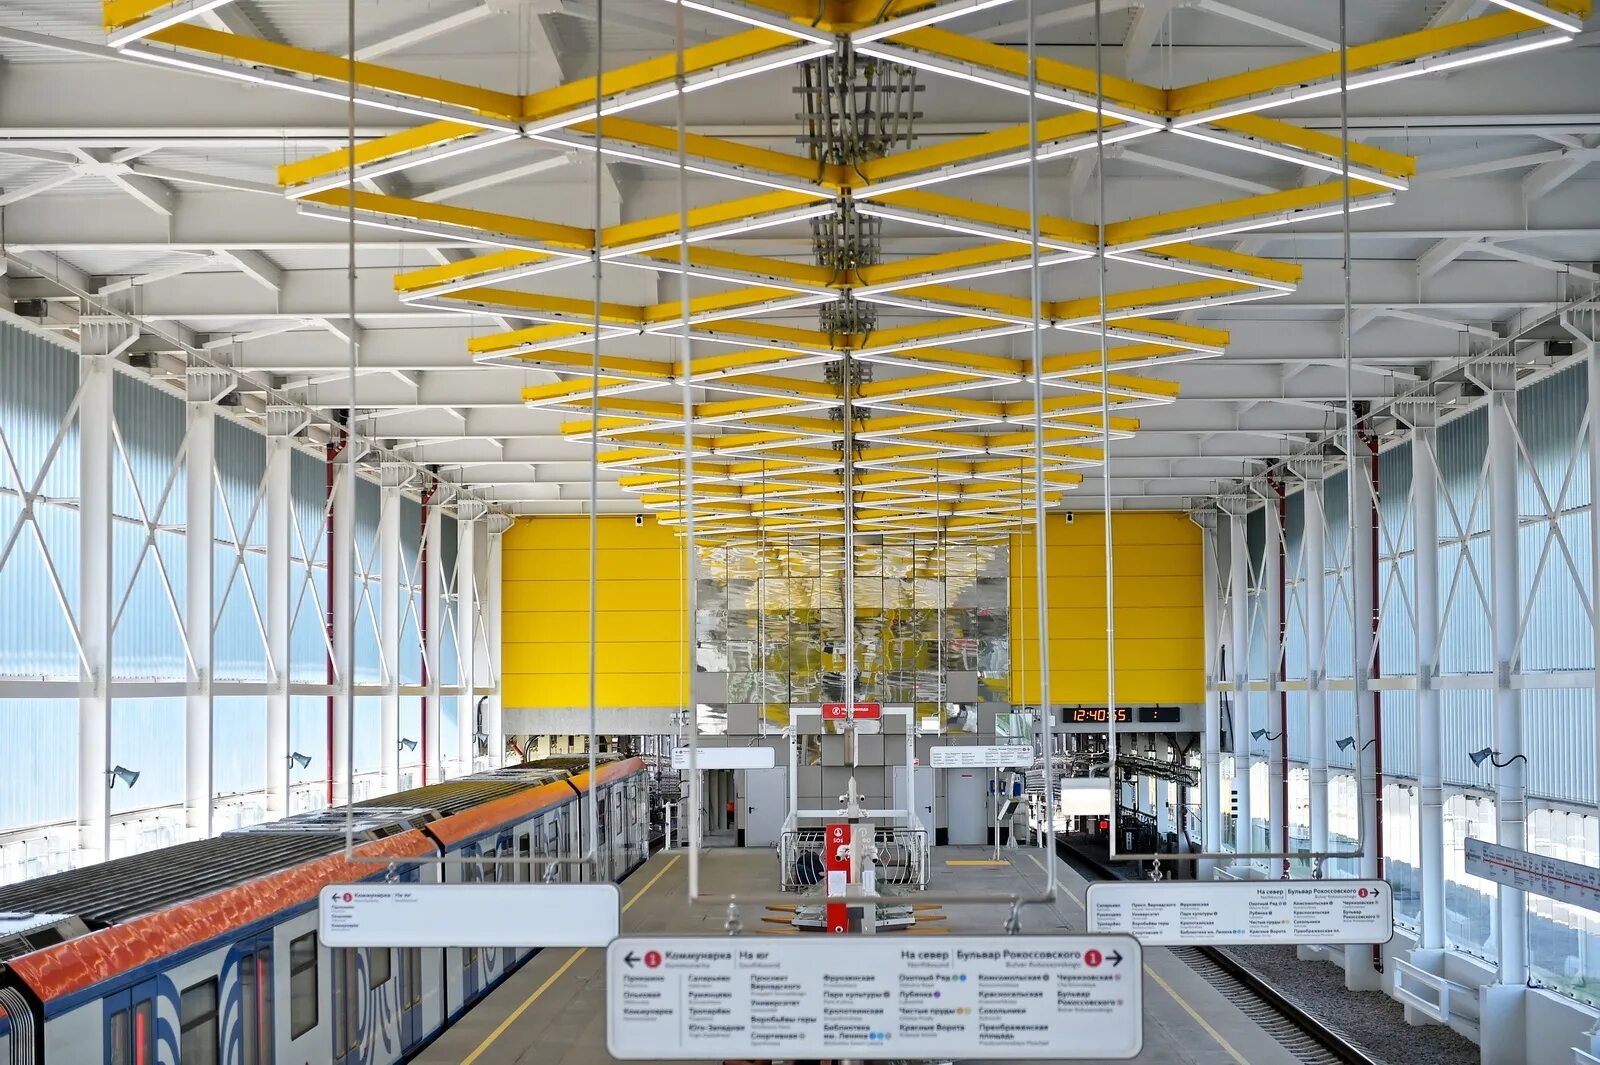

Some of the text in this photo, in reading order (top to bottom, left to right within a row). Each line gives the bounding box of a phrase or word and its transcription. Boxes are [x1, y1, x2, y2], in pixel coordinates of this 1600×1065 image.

[665, 951, 732, 962] Коммунарка
[901, 950, 949, 960] На север
[957, 949, 1000, 961] Бульвар
[1003, 950, 1081, 959] Рокоссовского
